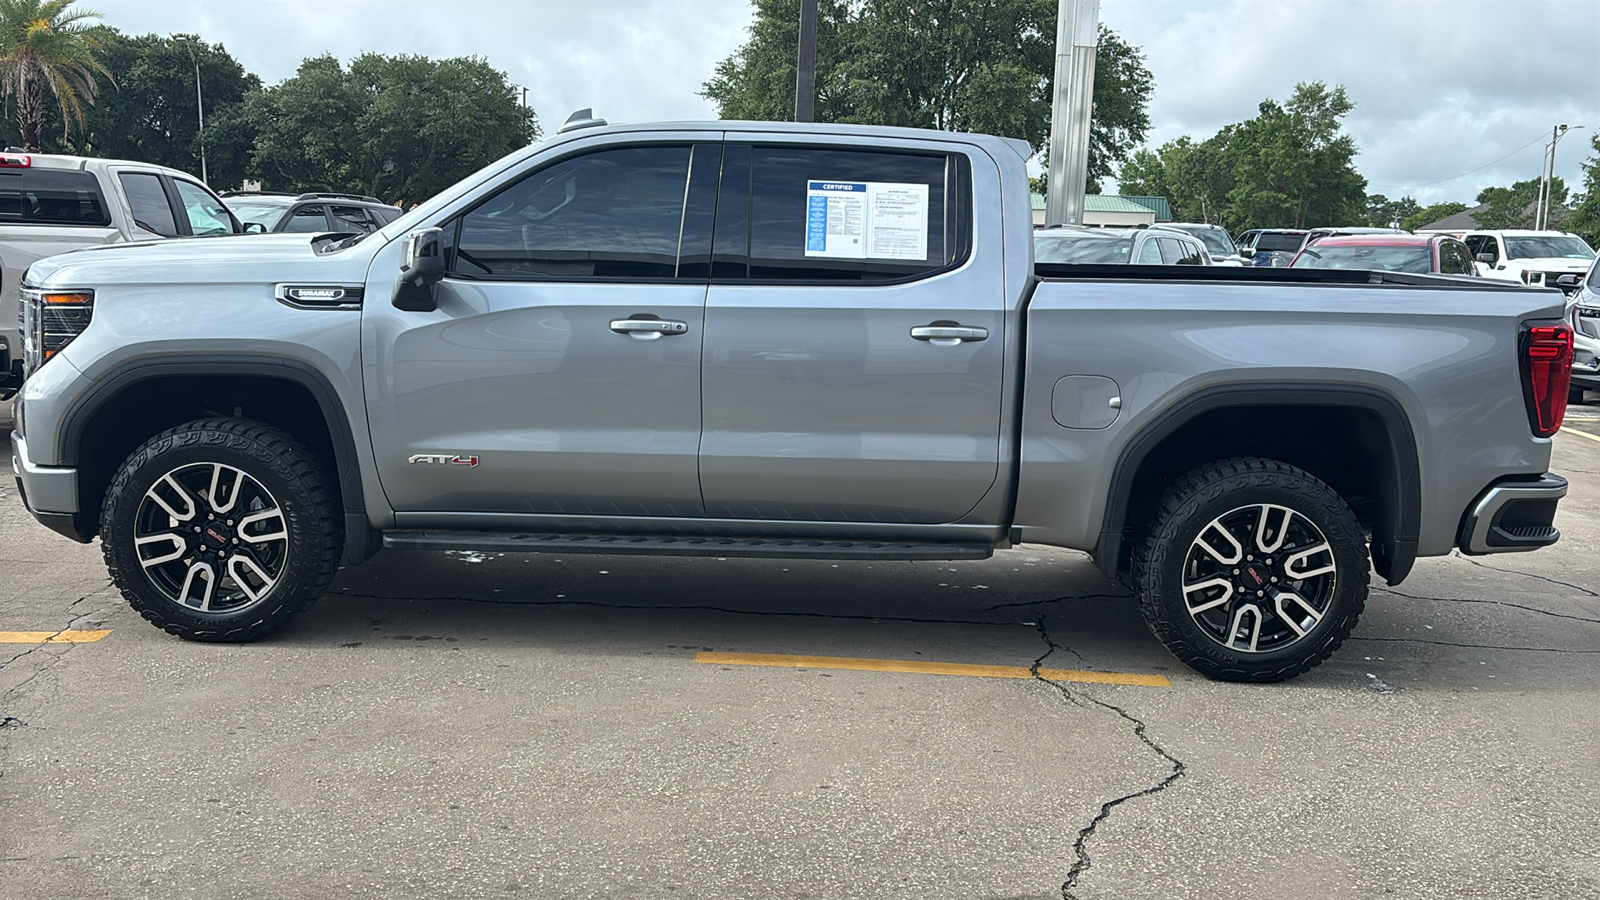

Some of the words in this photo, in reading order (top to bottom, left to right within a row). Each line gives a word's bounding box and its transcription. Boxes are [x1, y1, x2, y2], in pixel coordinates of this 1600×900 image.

[298, 289, 335, 297] DURAMAX
[408, 454, 479, 468] AT4
[207, 528, 226, 543] GMC
[1247, 567, 1263, 585] GMC
